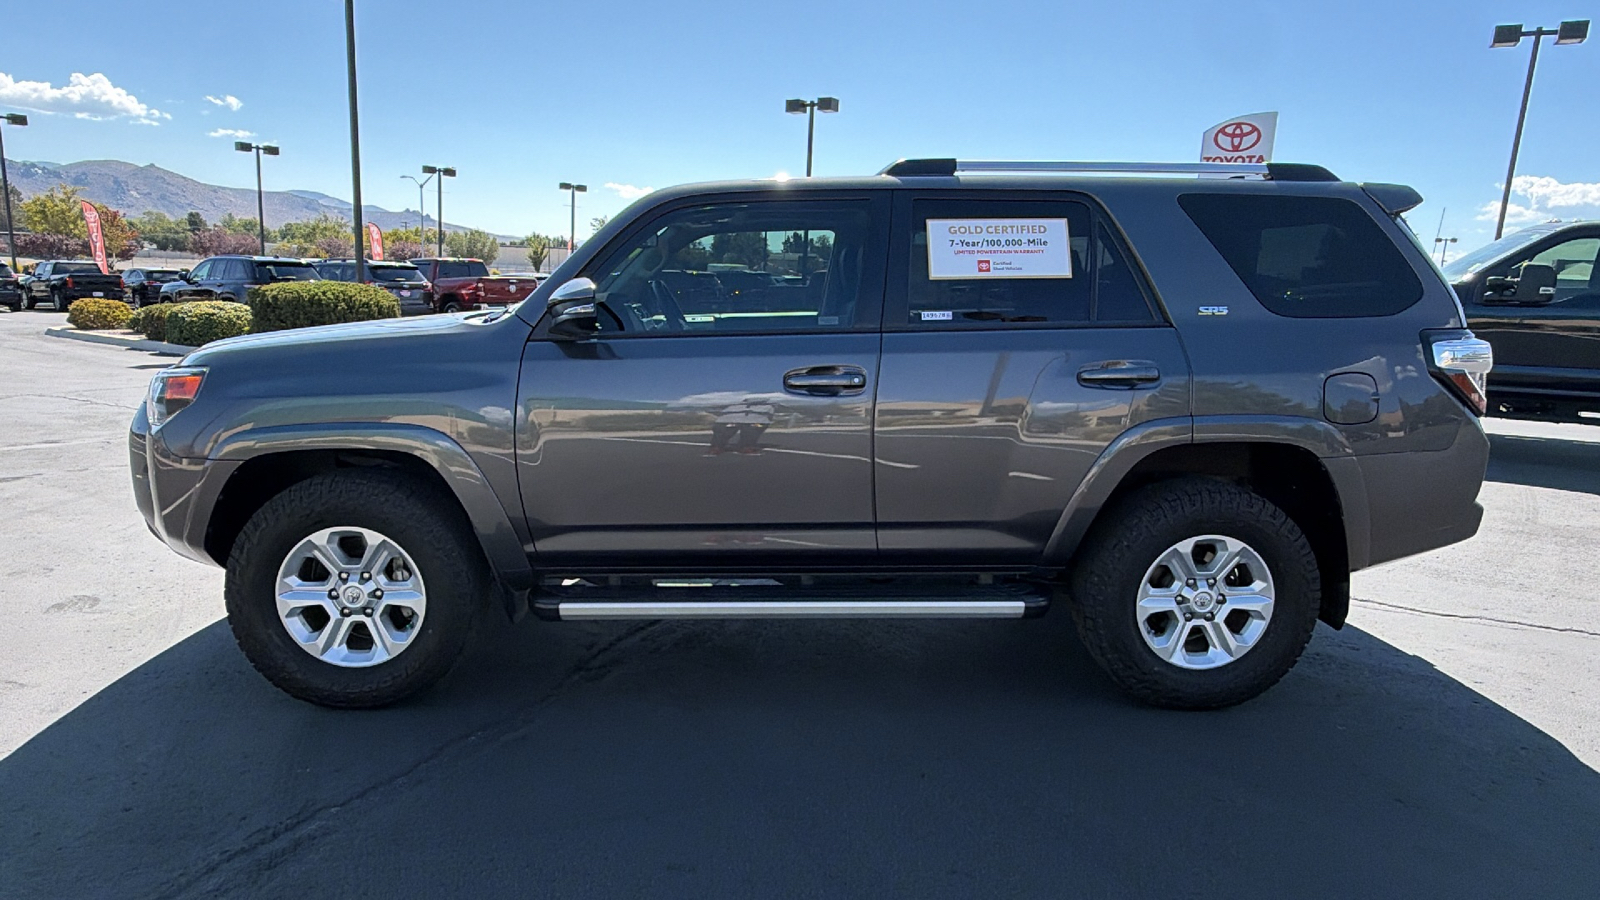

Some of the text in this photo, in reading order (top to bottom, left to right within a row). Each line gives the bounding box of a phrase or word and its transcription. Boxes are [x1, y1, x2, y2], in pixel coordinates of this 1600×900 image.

[948, 224, 1047, 235] GOLD CERTIFIED
[949, 238, 1048, 248] 7-Year/100,000-Mile
[1198, 306, 1229, 315] SR5
